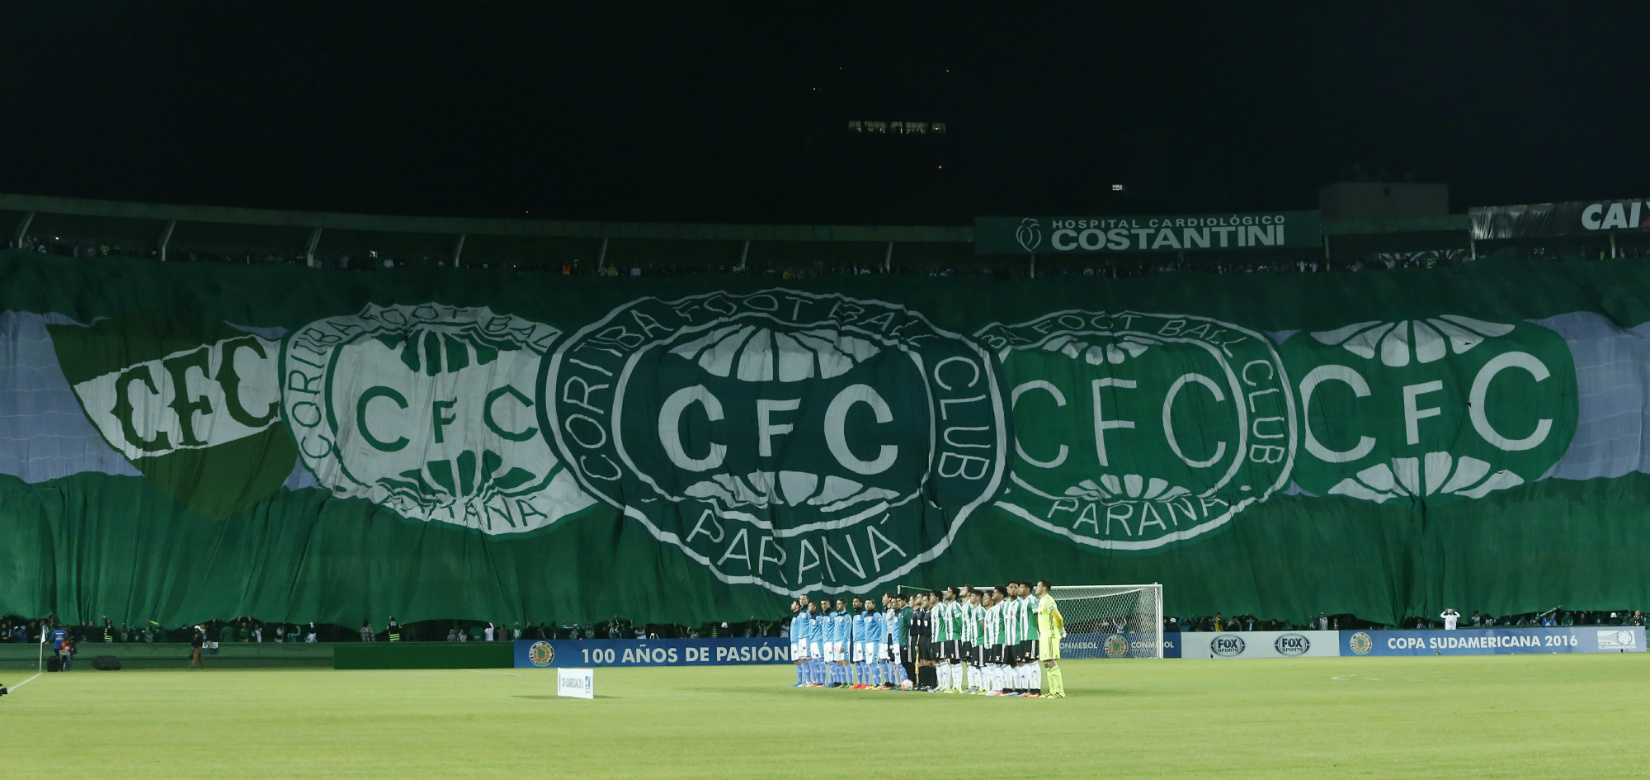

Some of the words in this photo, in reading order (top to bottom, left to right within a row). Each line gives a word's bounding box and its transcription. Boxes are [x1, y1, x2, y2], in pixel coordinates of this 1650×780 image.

[1052, 218, 1140, 229] HOSPITAL
[1149, 215, 1285, 228] CARDIOLÓGICO
[1051, 225, 1284, 251] COSTANTINI
[110, 337, 281, 451] CFC
[563, 309, 675, 481] CORITIBA
[673, 294, 814, 323] FOOT
[934, 356, 991, 481] CLUB
[1241, 359, 1285, 465] CLUB
[658, 384, 898, 475] CFC
[686, 509, 906, 585] PARANÁ
[581, 648, 615, 664] 100
[622, 644, 678, 663] AÑOS
[685, 647, 710, 662] DE
[716, 642, 789, 662] PASIÓN
[1131, 640, 1174, 649] CONMOL
[1218, 639, 1238, 649] FOX
[1282, 638, 1302, 647] FOX
[1387, 637, 1426, 649] COPA
[1430, 635, 1540, 648] SUDAMERICANA
[1545, 635, 1578, 647] 2016
